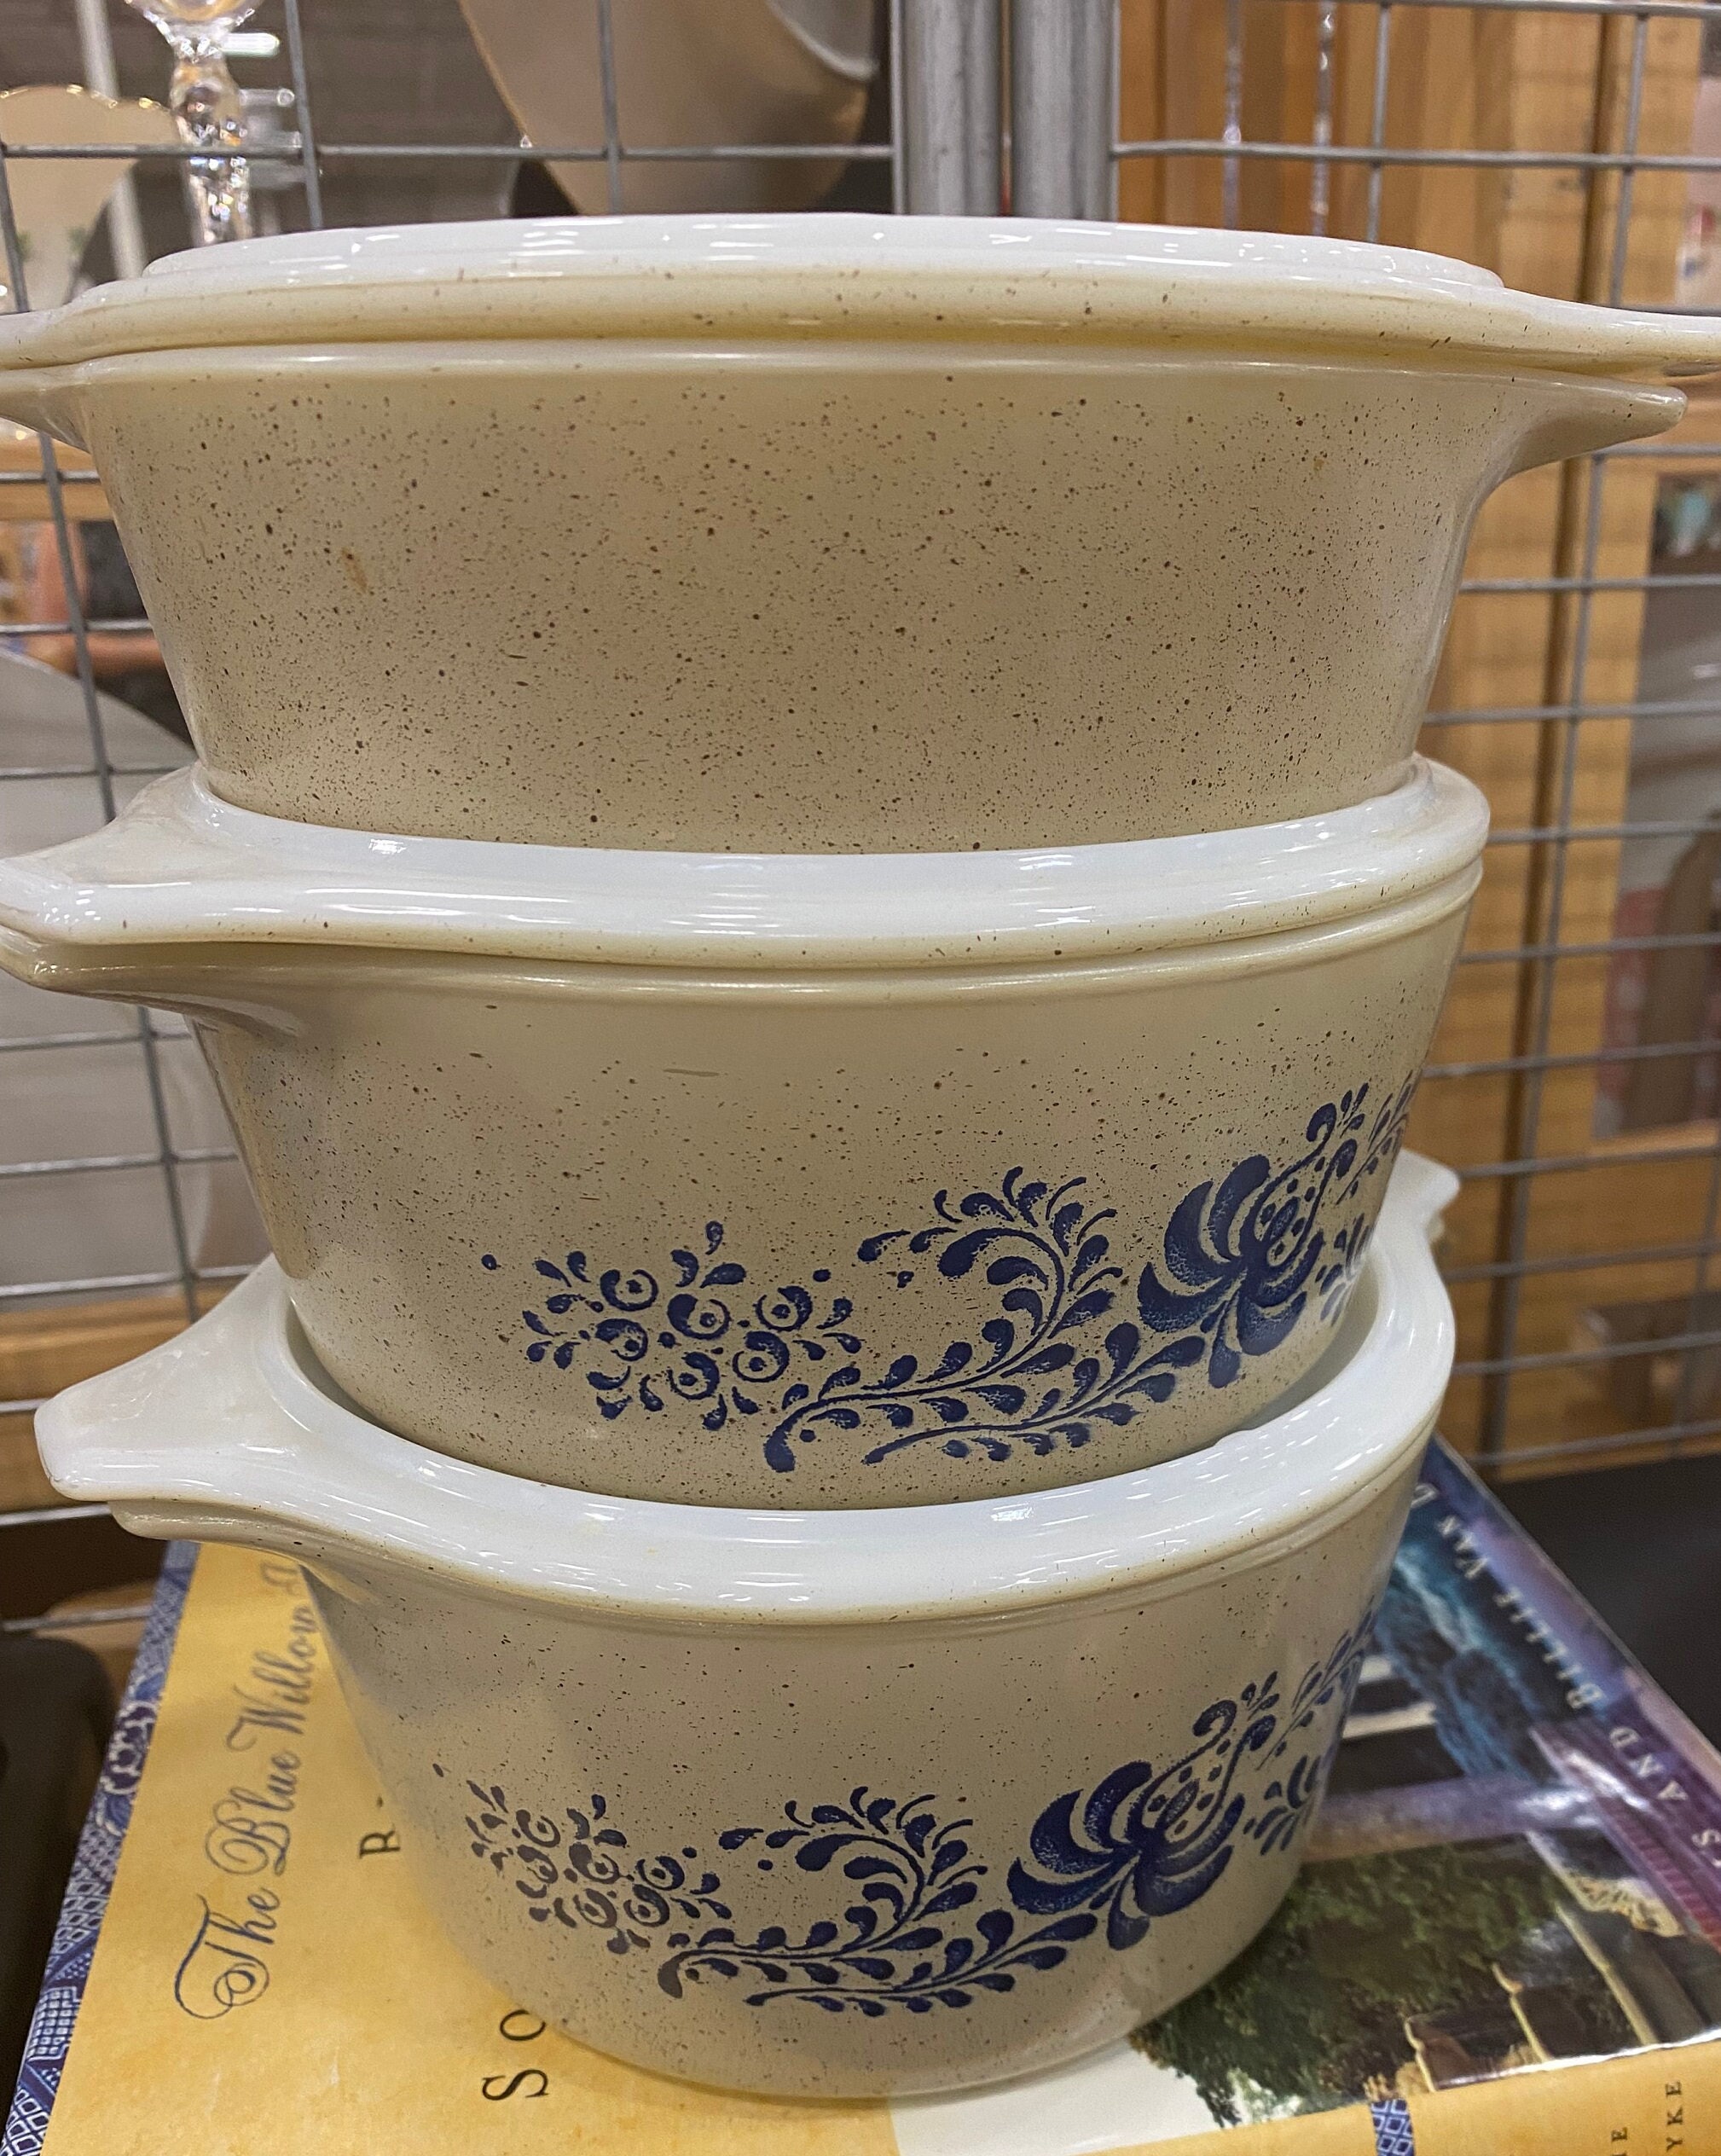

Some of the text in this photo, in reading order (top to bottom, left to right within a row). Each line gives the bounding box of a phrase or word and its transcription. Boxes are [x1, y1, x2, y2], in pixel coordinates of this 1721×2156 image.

[226, 1605, 316, 1751] Willow
[205, 1749, 303, 1876] Blue
[1609, 1726, 1689, 1801] AND
[176, 1887, 281, 2020] The
